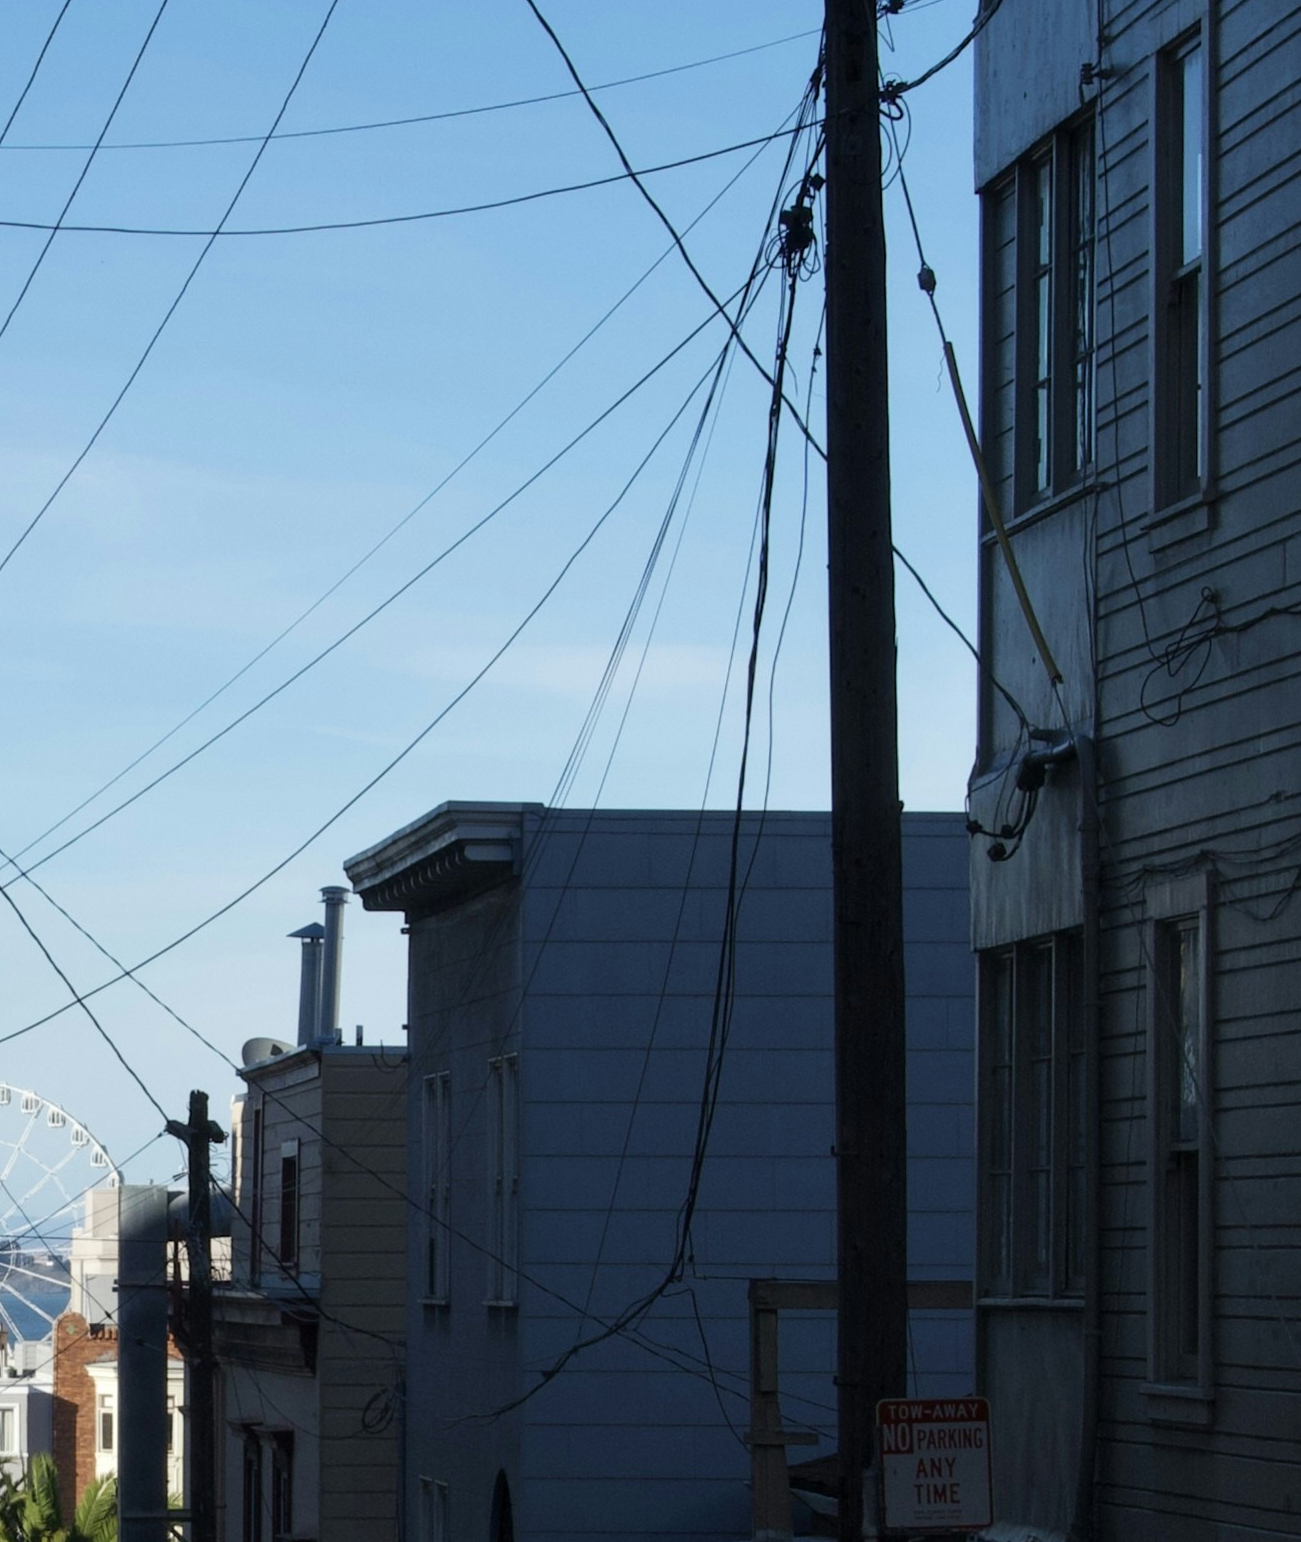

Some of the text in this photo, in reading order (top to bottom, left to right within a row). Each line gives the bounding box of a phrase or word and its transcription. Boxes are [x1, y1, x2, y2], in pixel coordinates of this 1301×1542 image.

[887, 1403, 979, 1420] TOW-AWAY
[883, 1422, 983, 1452] NO PARKING
[916, 1457, 957, 1479] ANY
[913, 1483, 961, 1505] TIME
